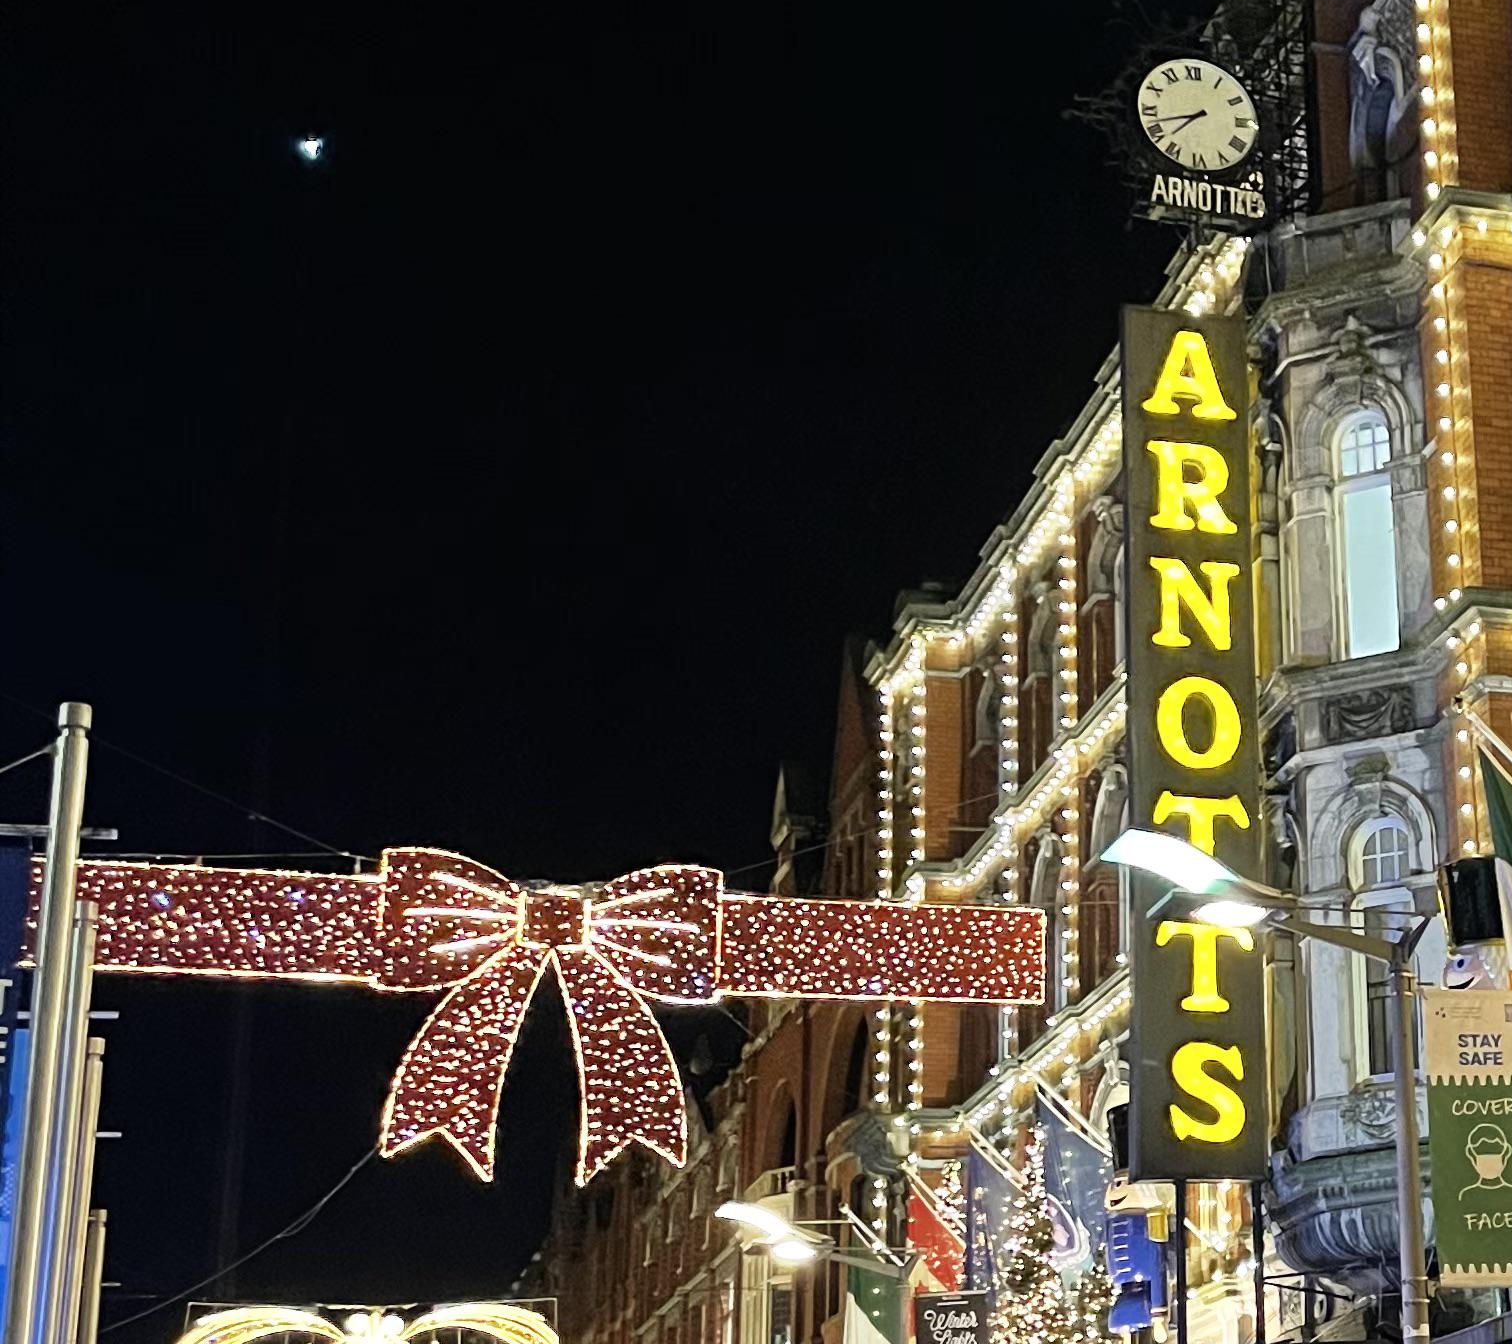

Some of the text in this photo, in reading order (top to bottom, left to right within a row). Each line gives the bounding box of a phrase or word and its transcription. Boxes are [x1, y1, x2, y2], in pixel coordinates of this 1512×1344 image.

[1142, 329, 1255, 1145] ARNOTTS
[1457, 1033, 1503, 1049] STAY
[1458, 1051, 1504, 1067] SAFE
[923, 1309, 979, 1331] Winter
